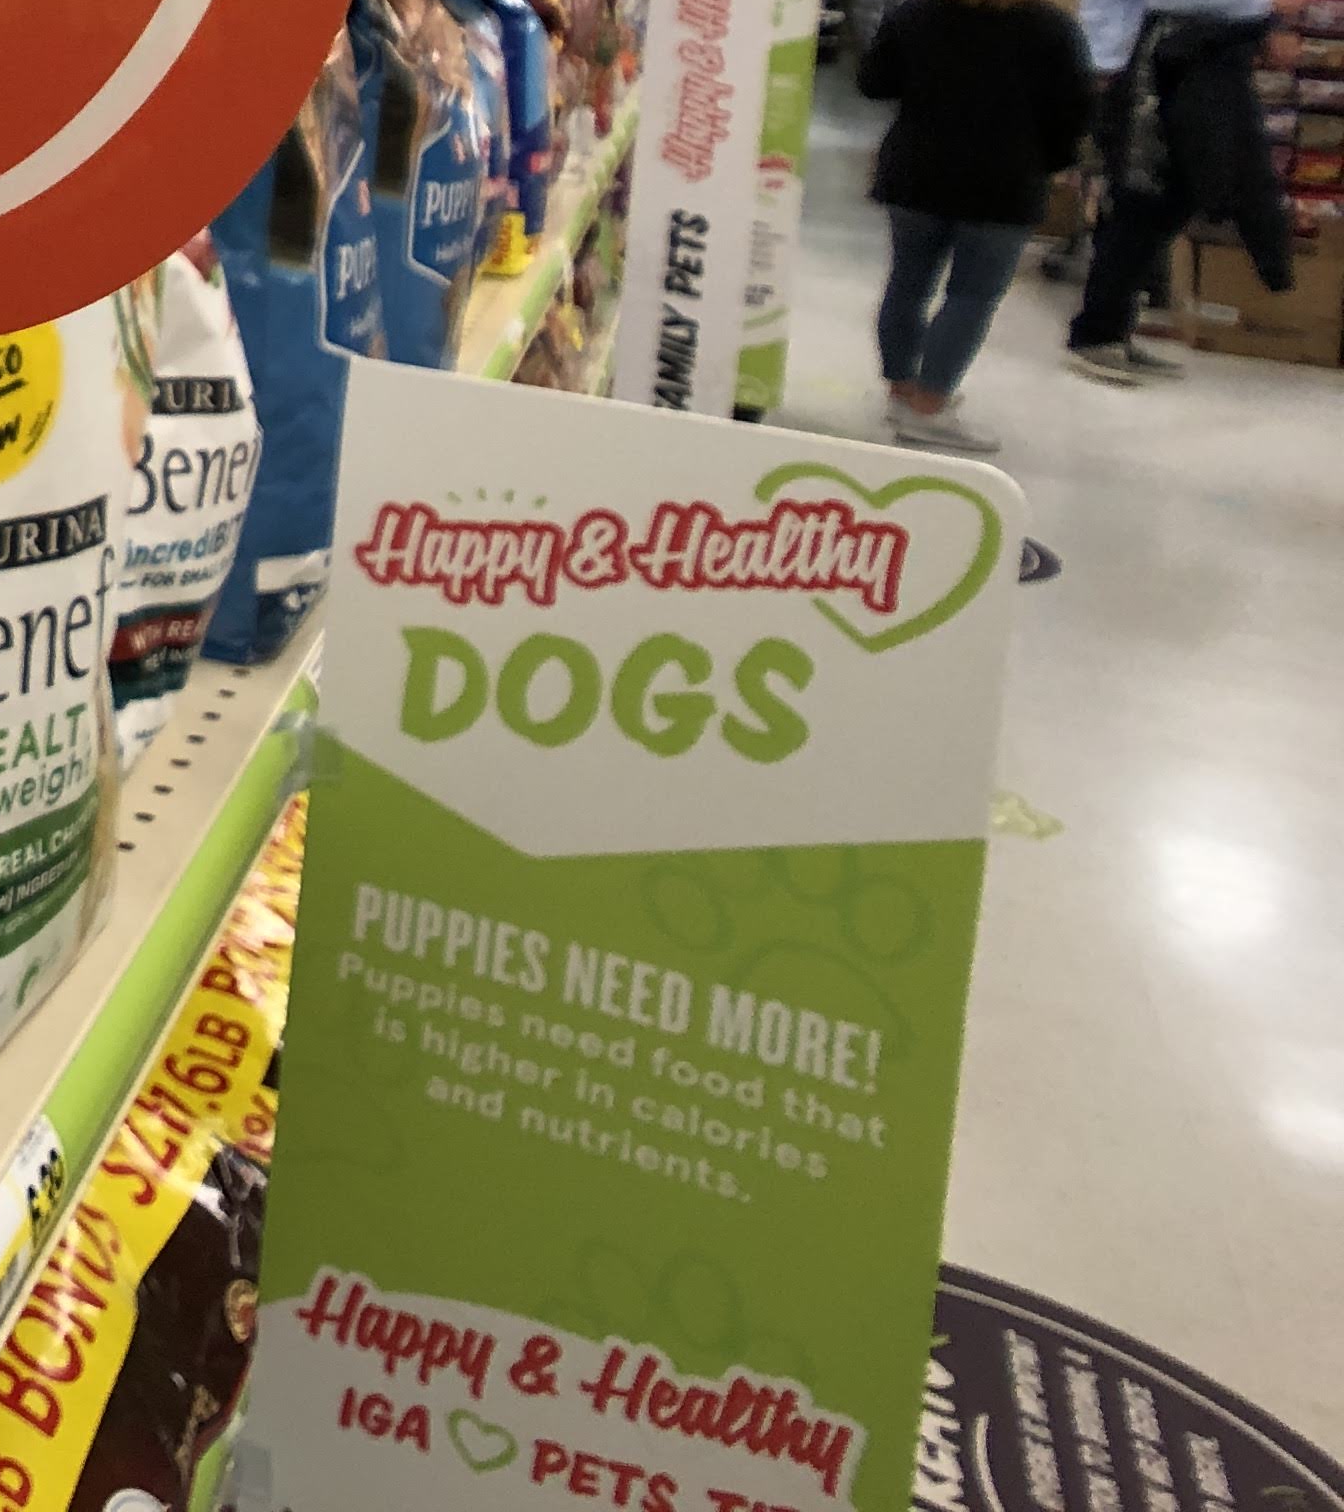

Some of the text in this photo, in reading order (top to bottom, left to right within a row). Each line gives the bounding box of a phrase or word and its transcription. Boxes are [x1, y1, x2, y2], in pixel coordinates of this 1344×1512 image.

[660, 84, 734, 183] Happy
[665, 209, 711, 300] PETS
[356, 500, 565, 607] Happy
[564, 509, 630, 589] &
[629, 498, 911, 614] Healthy
[400, 625, 815, 765] DOGS
[336, 953, 887, 1149] Puppies need food that
[353, 883, 552, 994] PUPPIES
[562, 940, 693, 1035] NEED
[706, 982, 884, 1094] MORE!
[373, 1008, 829, 1180] is higher in calories
[425, 1076, 753, 1205] and nutrients.
[295, 1273, 497, 1400] Happy
[506, 1334, 565, 1397] &
[581, 1344, 855, 1498] Healthy
[338, 1387, 678, 1512] IGA PETS
